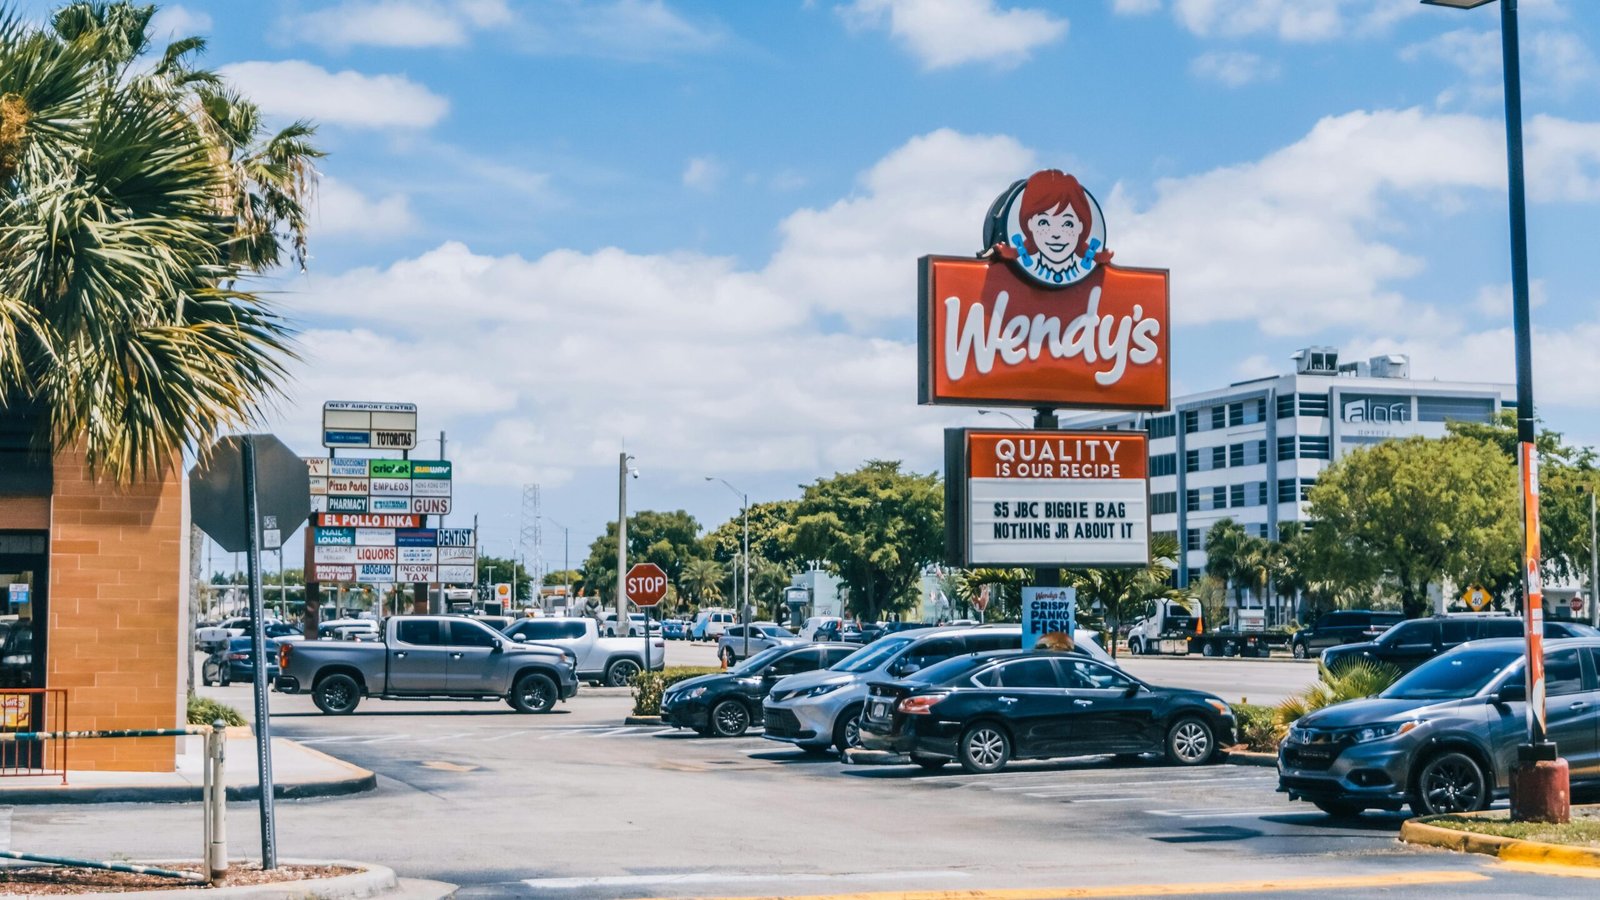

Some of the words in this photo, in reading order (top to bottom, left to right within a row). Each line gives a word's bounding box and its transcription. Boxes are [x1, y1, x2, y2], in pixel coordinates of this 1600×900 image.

[945, 286, 1161, 385] Wendy's
[1344, 399, 1406, 424] aloft
[376, 431, 412, 446] TOTORITAS
[995, 439, 1121, 462] QUALITY
[373, 464, 409, 473] cricket
[996, 463, 1011, 477] IS
[1017, 463, 1053, 477] OUR
[1060, 464, 1121, 477] RECIPE
[329, 480, 347, 491] Pizza
[349, 481, 367, 491] Pasta
[373, 482, 409, 491] EMPLEOS
[330, 498, 366, 510] PHARMACY
[414, 499, 447, 512] GUNS
[994, 502, 1009, 518] $5
[1014, 502, 1038, 518] JBC
[1045, 502, 1088, 518] BIGGIE
[1095, 503, 1126, 518] BAG
[324, 514, 338, 526] EL
[342, 514, 381, 527] POLLO
[384, 515, 413, 527] INKA
[994, 522, 1051, 539] NOTHING
[1055, 523, 1069, 539] JR
[1074, 523, 1115, 539] ABOUT
[1121, 523, 1133, 539] IT
[439, 530, 471, 546] DENTIST
[357, 549, 395, 560] LIQUORS
[361, 564, 391, 574] ABOGADO
[405, 573, 428, 581] TAX
[628, 576, 664, 593] STOP
[1031, 601, 1070, 610] CRISPY
[1031, 611, 1070, 620] PANKO
[1031, 620, 1070, 634] FISH
